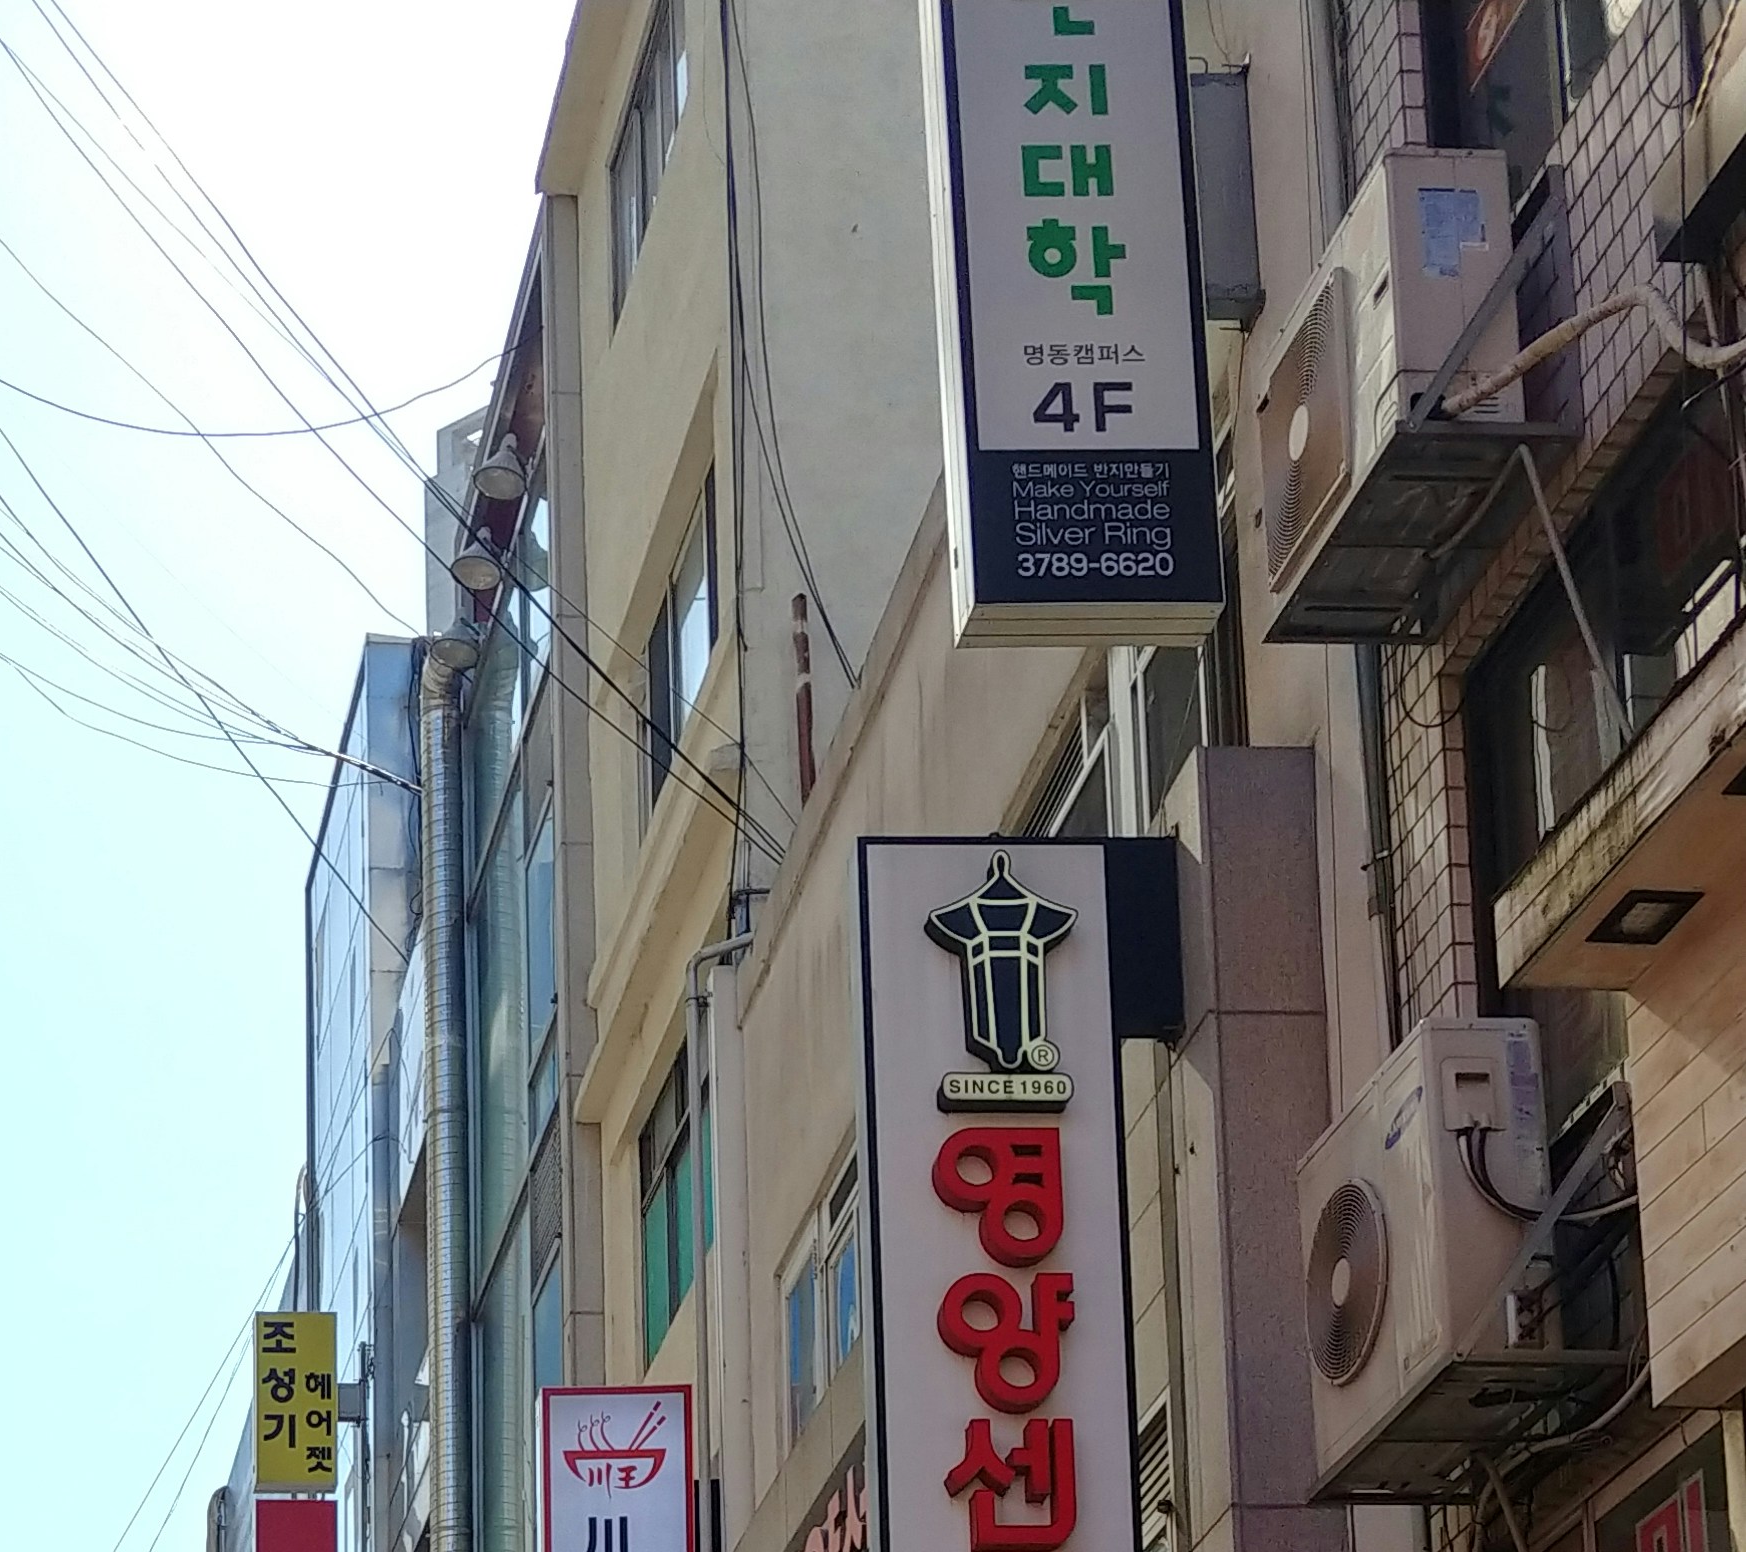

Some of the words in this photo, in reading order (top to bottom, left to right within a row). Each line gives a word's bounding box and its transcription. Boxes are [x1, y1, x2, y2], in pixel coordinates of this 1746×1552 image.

[1021, 0, 1127, 316] 지대학
[1023, 342, 1146, 366] 명동캠퍼스
[1032, 381, 1135, 433] 4F
[1012, 463, 1088, 480] 핸드메이드
[1093, 463, 1170, 480] 반지만들기
[1012, 480, 1075, 498] Make
[1081, 480, 1170, 498] Yourself
[1012, 499, 1171, 521] Handmade
[1014, 522, 1096, 546] Silver
[1103, 522, 1173, 551] Ring
[1016, 552, 1175, 578] 3789-6620
[949, 1078, 1014, 1096] SINCE
[1019, 1078, 1068, 1096] 1960
[261, 1322, 297, 1449] 조성기
